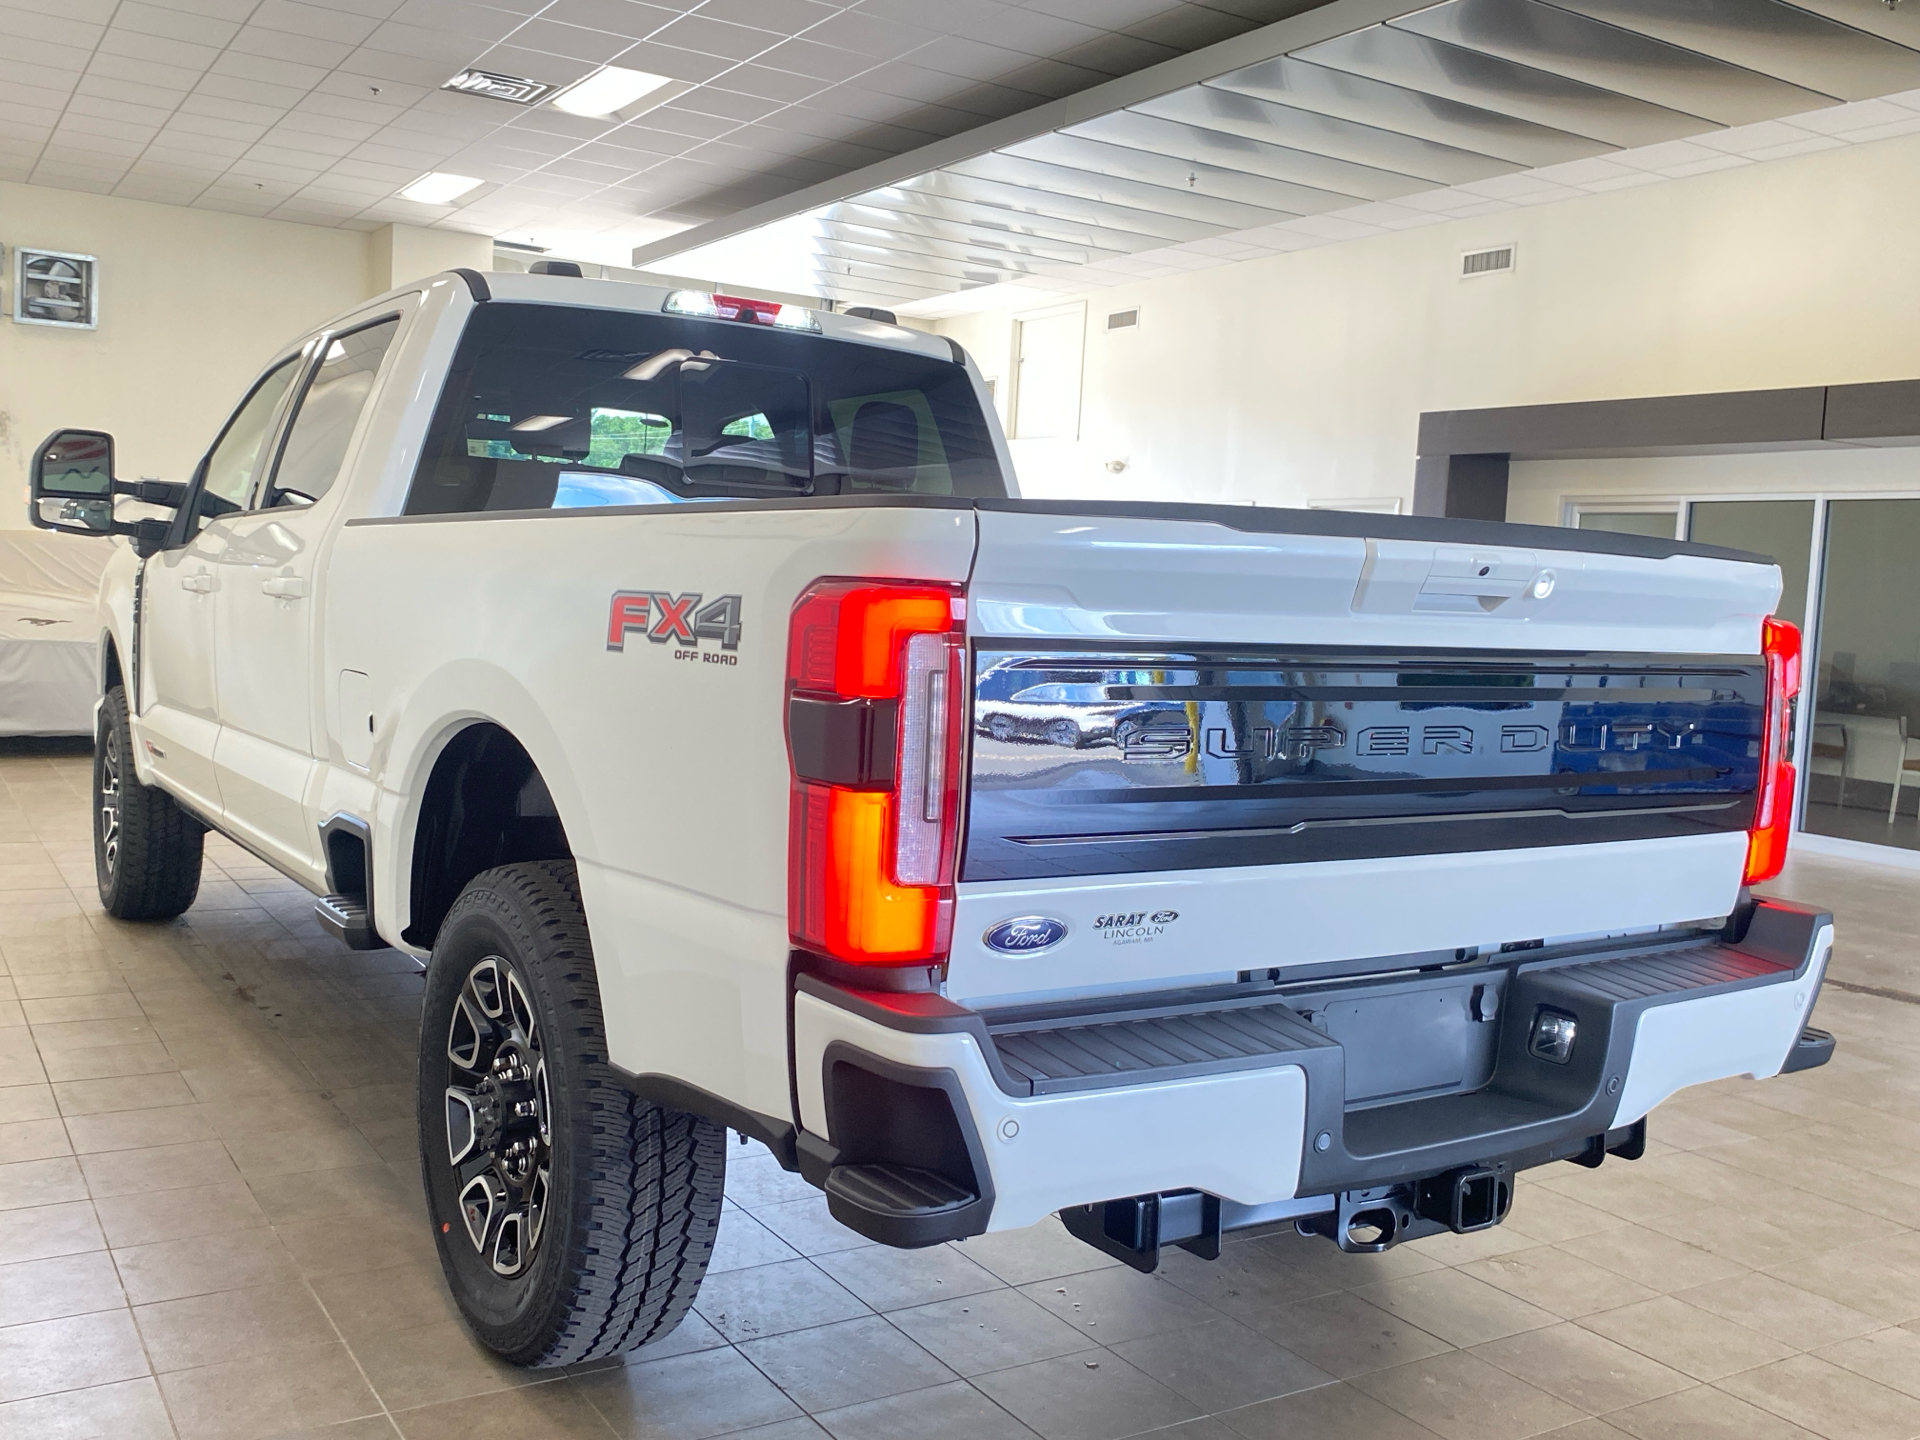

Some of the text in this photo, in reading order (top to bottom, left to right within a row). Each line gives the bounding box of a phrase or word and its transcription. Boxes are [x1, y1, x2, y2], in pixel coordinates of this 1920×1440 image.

[606, 590, 742, 652] FX4
[674, 650, 737, 666] OFF ROAD
[1124, 722, 1696, 761] SUPER DUTY
[1094, 912, 1147, 929] SARAT
[1005, 924, 1051, 948] Ford
[1103, 926, 1164, 940] LINCOLN
